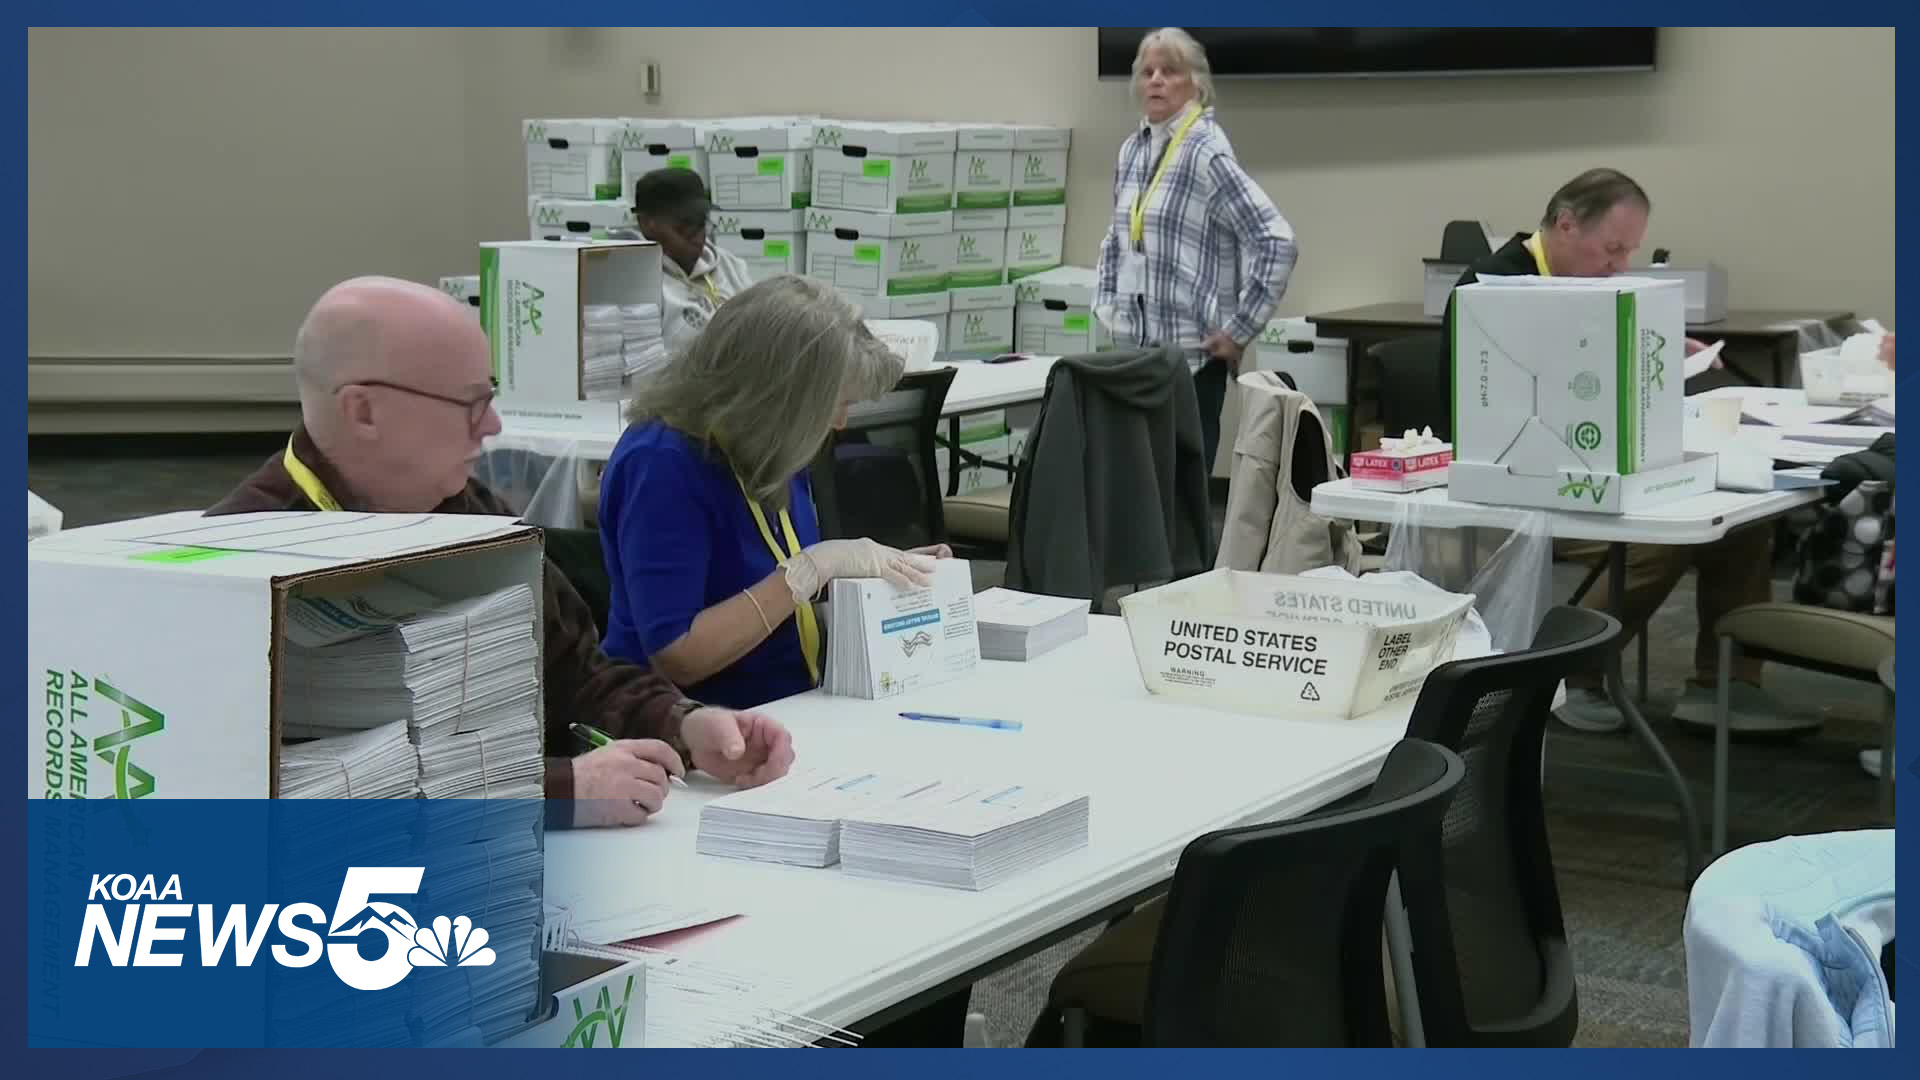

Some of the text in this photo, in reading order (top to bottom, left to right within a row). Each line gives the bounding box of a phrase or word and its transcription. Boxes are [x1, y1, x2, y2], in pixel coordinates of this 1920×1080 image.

[1365, 456, 1389, 468] LATEX
[1169, 620, 1318, 652] UNITED STATES
[1383, 632, 1412, 647] LABEL
[1163, 641, 1328, 676] POSTAL SERVICE
[1377, 645, 1409, 659] OTHER
[1169, 666, 1206, 678] WARNING
[1378, 658, 1398, 671] END
[70, 669, 89, 724] ALL
[44, 668, 64, 804] RECORDS
